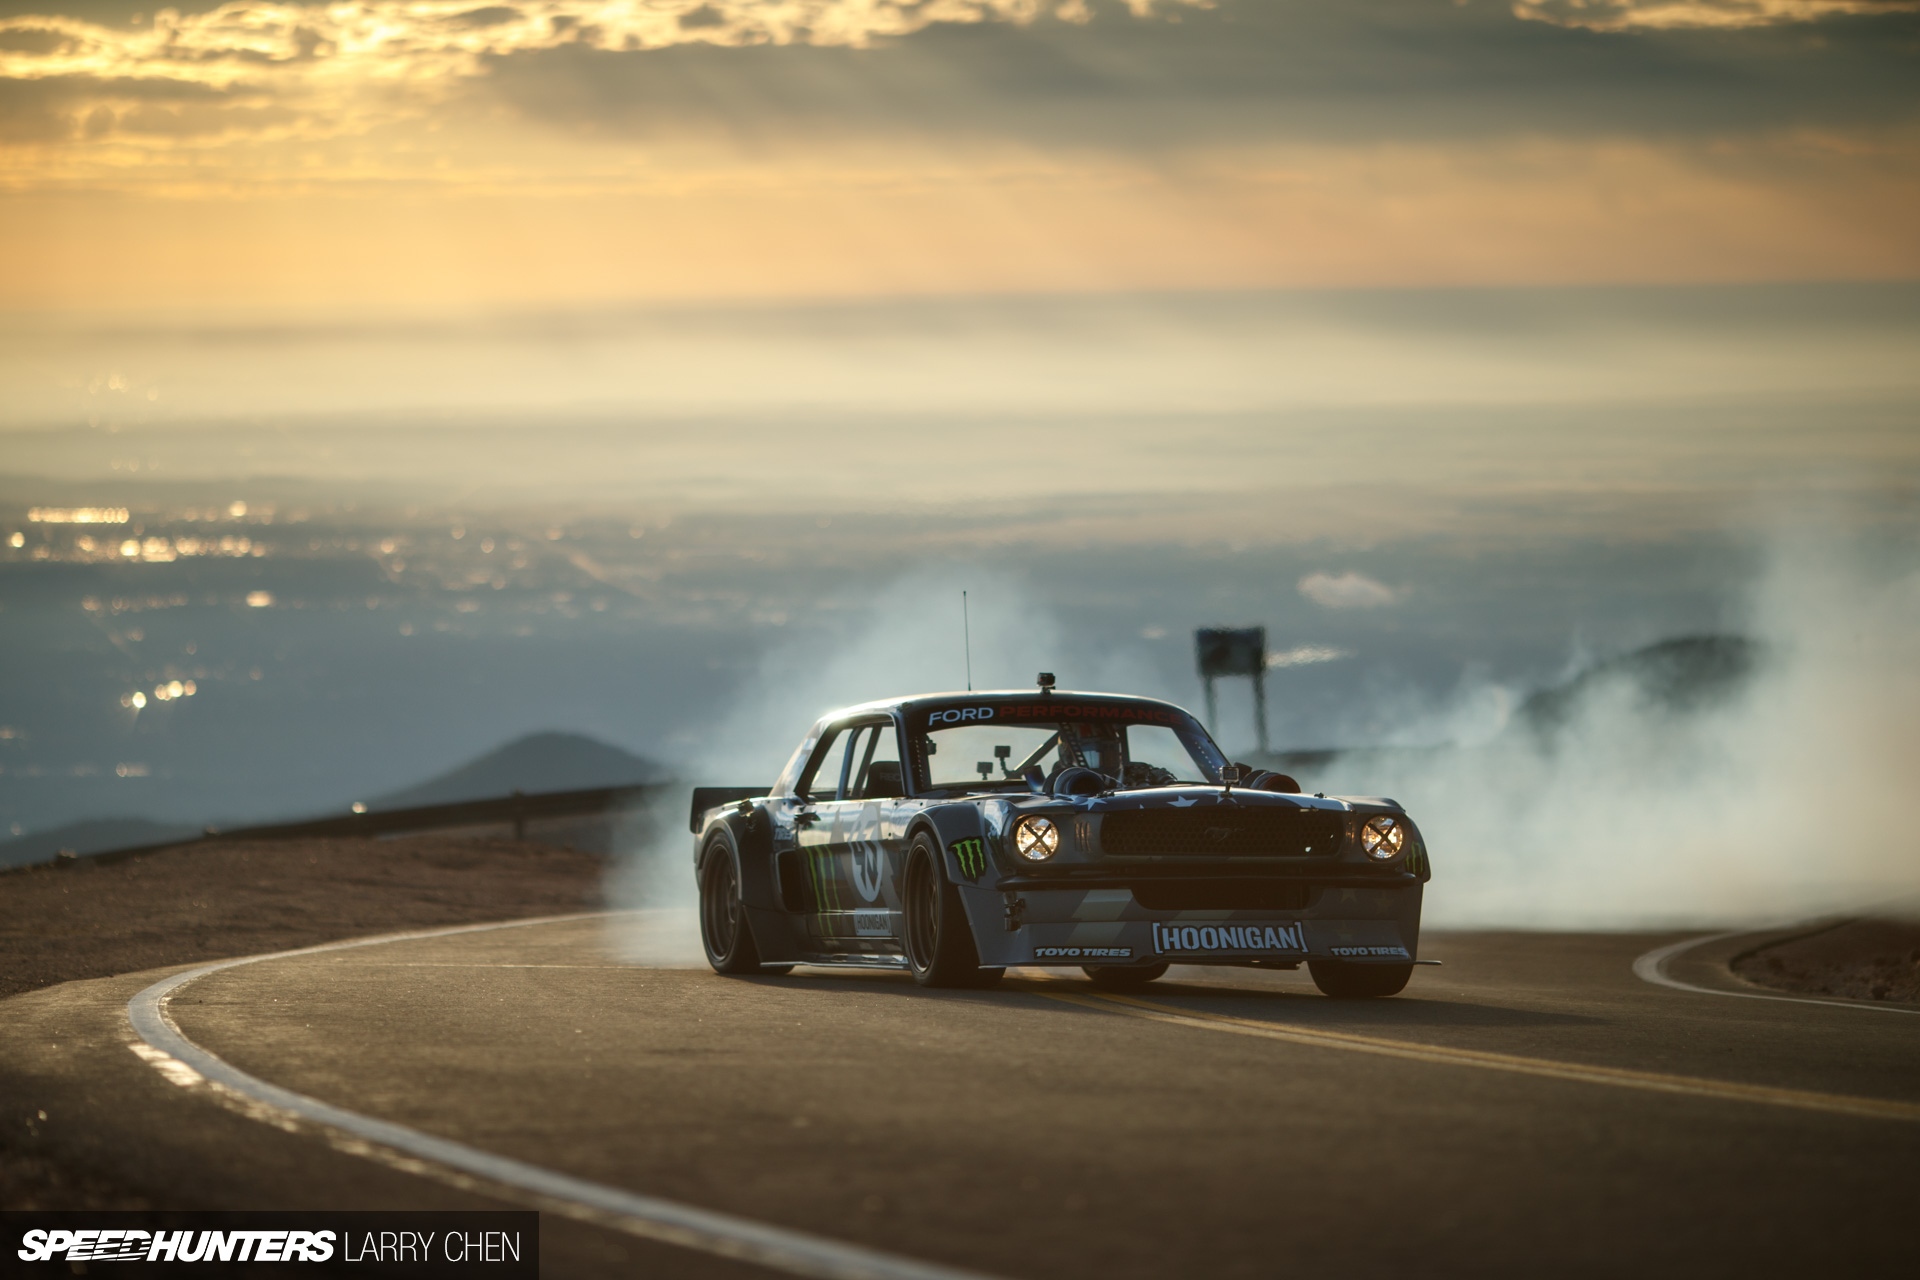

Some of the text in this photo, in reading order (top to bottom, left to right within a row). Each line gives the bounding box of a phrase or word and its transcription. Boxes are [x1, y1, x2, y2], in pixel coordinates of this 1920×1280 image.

[928, 705, 1183, 726] FORD PERFORMANCE
[1035, 947, 1131, 957] TOYO TIRES
[1331, 946, 1407, 956] TOYO TIRES
